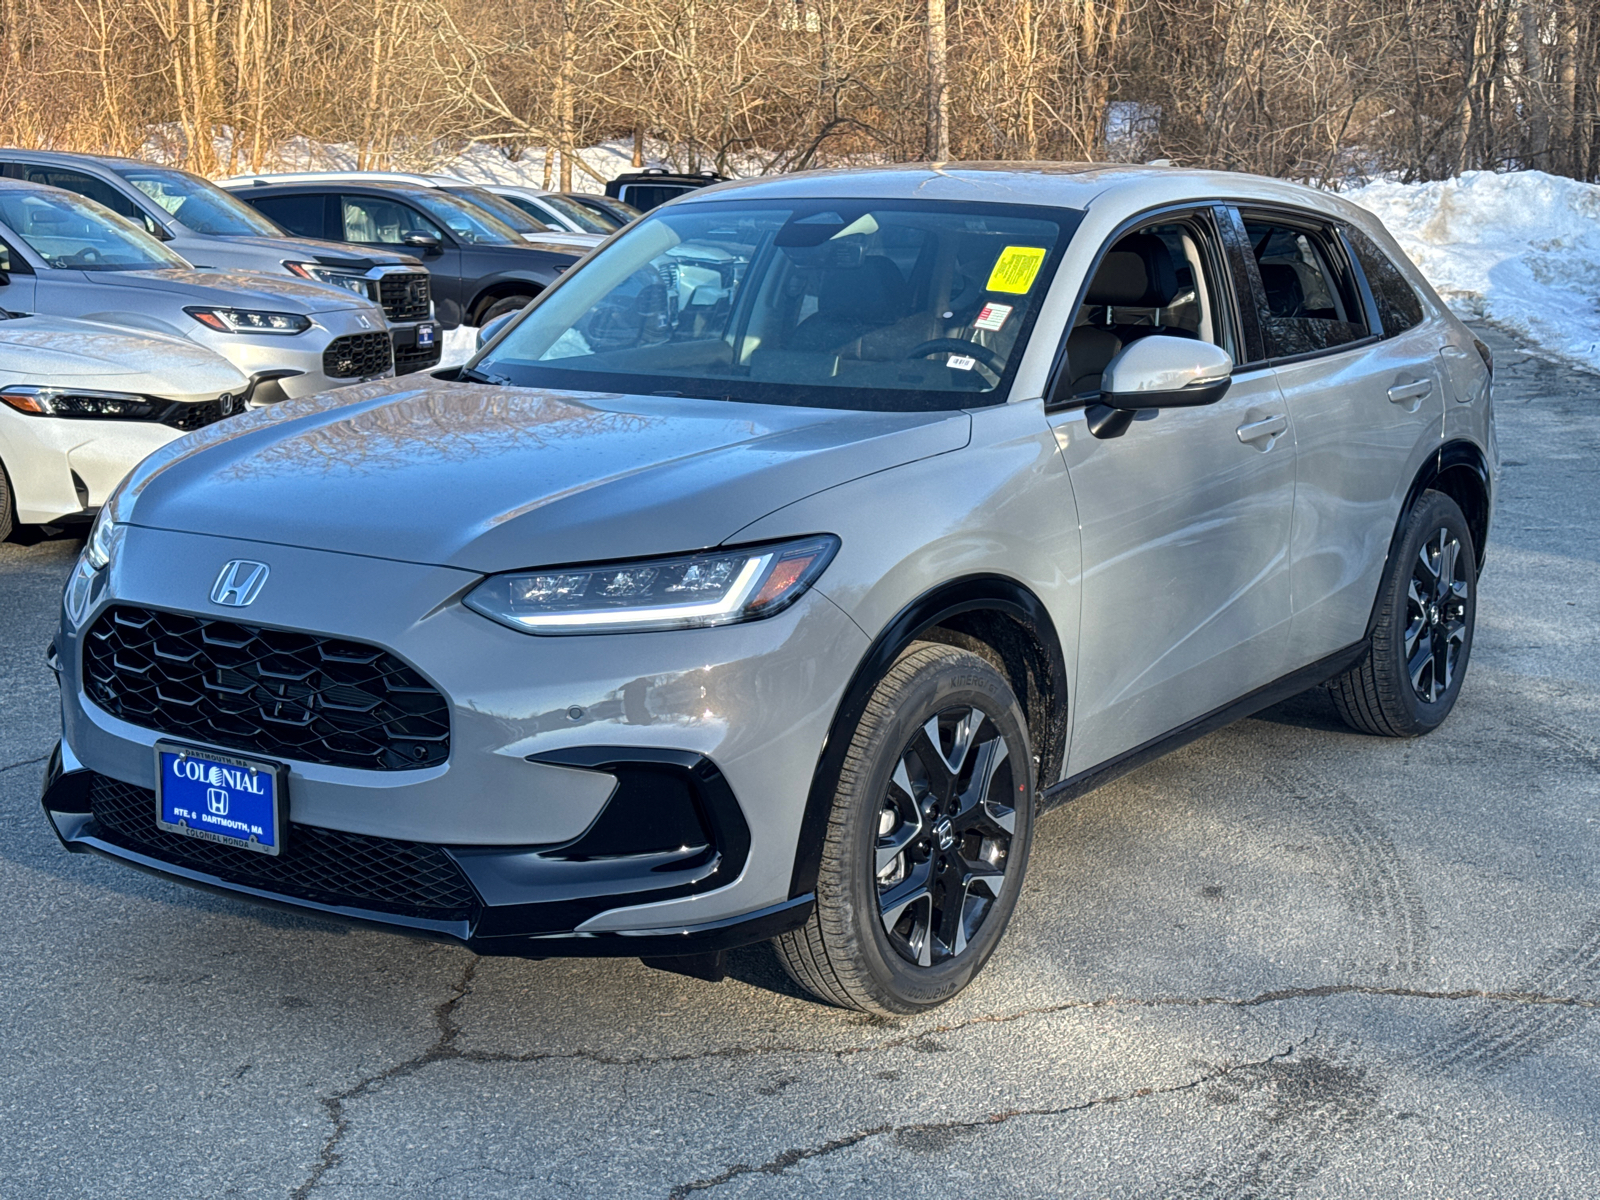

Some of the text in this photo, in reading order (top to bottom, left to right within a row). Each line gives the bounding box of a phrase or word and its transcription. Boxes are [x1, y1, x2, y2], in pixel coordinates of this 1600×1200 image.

[235, 757, 248, 767] MA
[173, 758, 264, 795] COLONIAL
[173, 807, 263, 836] RTE. 6 DARTMOUTH, MA
[185, 828, 250, 849] COLONIAL HONDA
